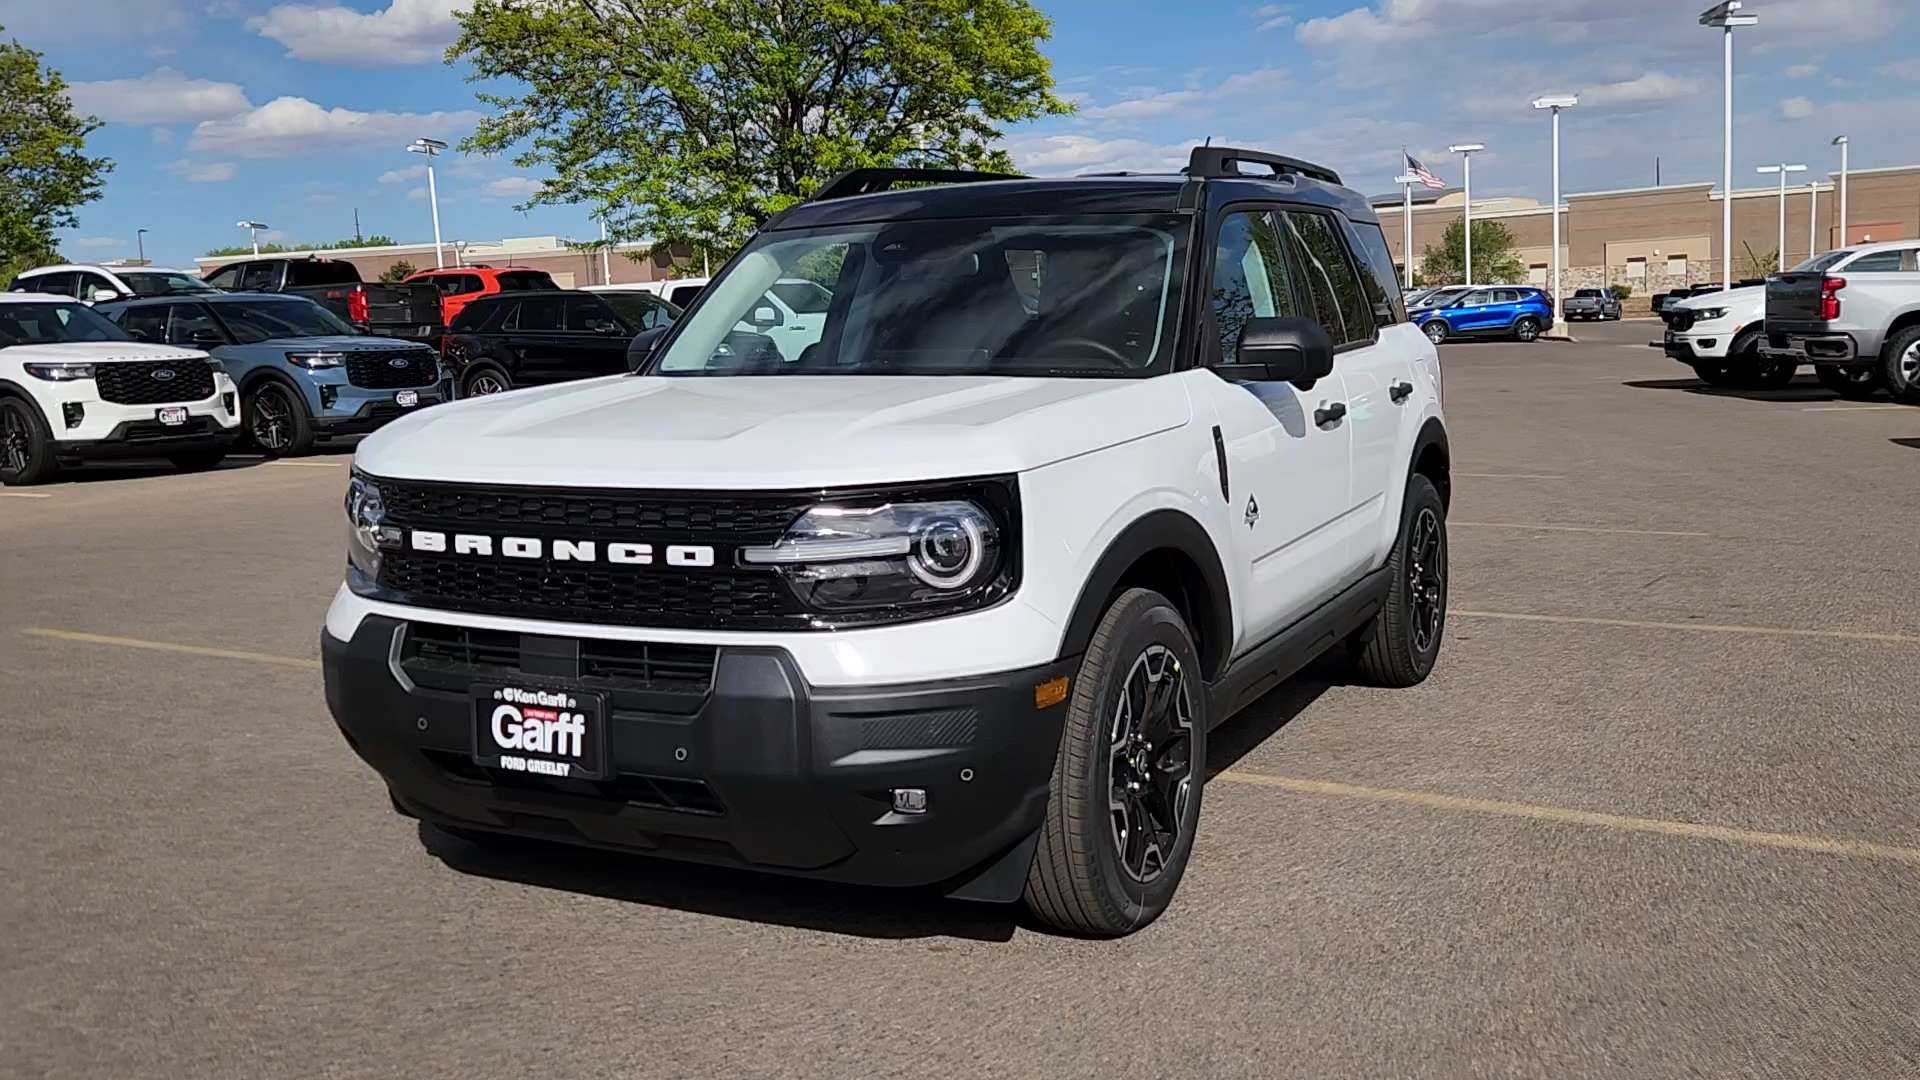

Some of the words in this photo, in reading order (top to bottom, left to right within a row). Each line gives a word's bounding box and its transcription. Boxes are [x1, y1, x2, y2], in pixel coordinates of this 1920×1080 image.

[412, 530, 714, 567] BRONCO
[491, 704, 586, 757] Garff
[500, 755, 526, 771] FORD
[527, 758, 570, 777] GREELEY
